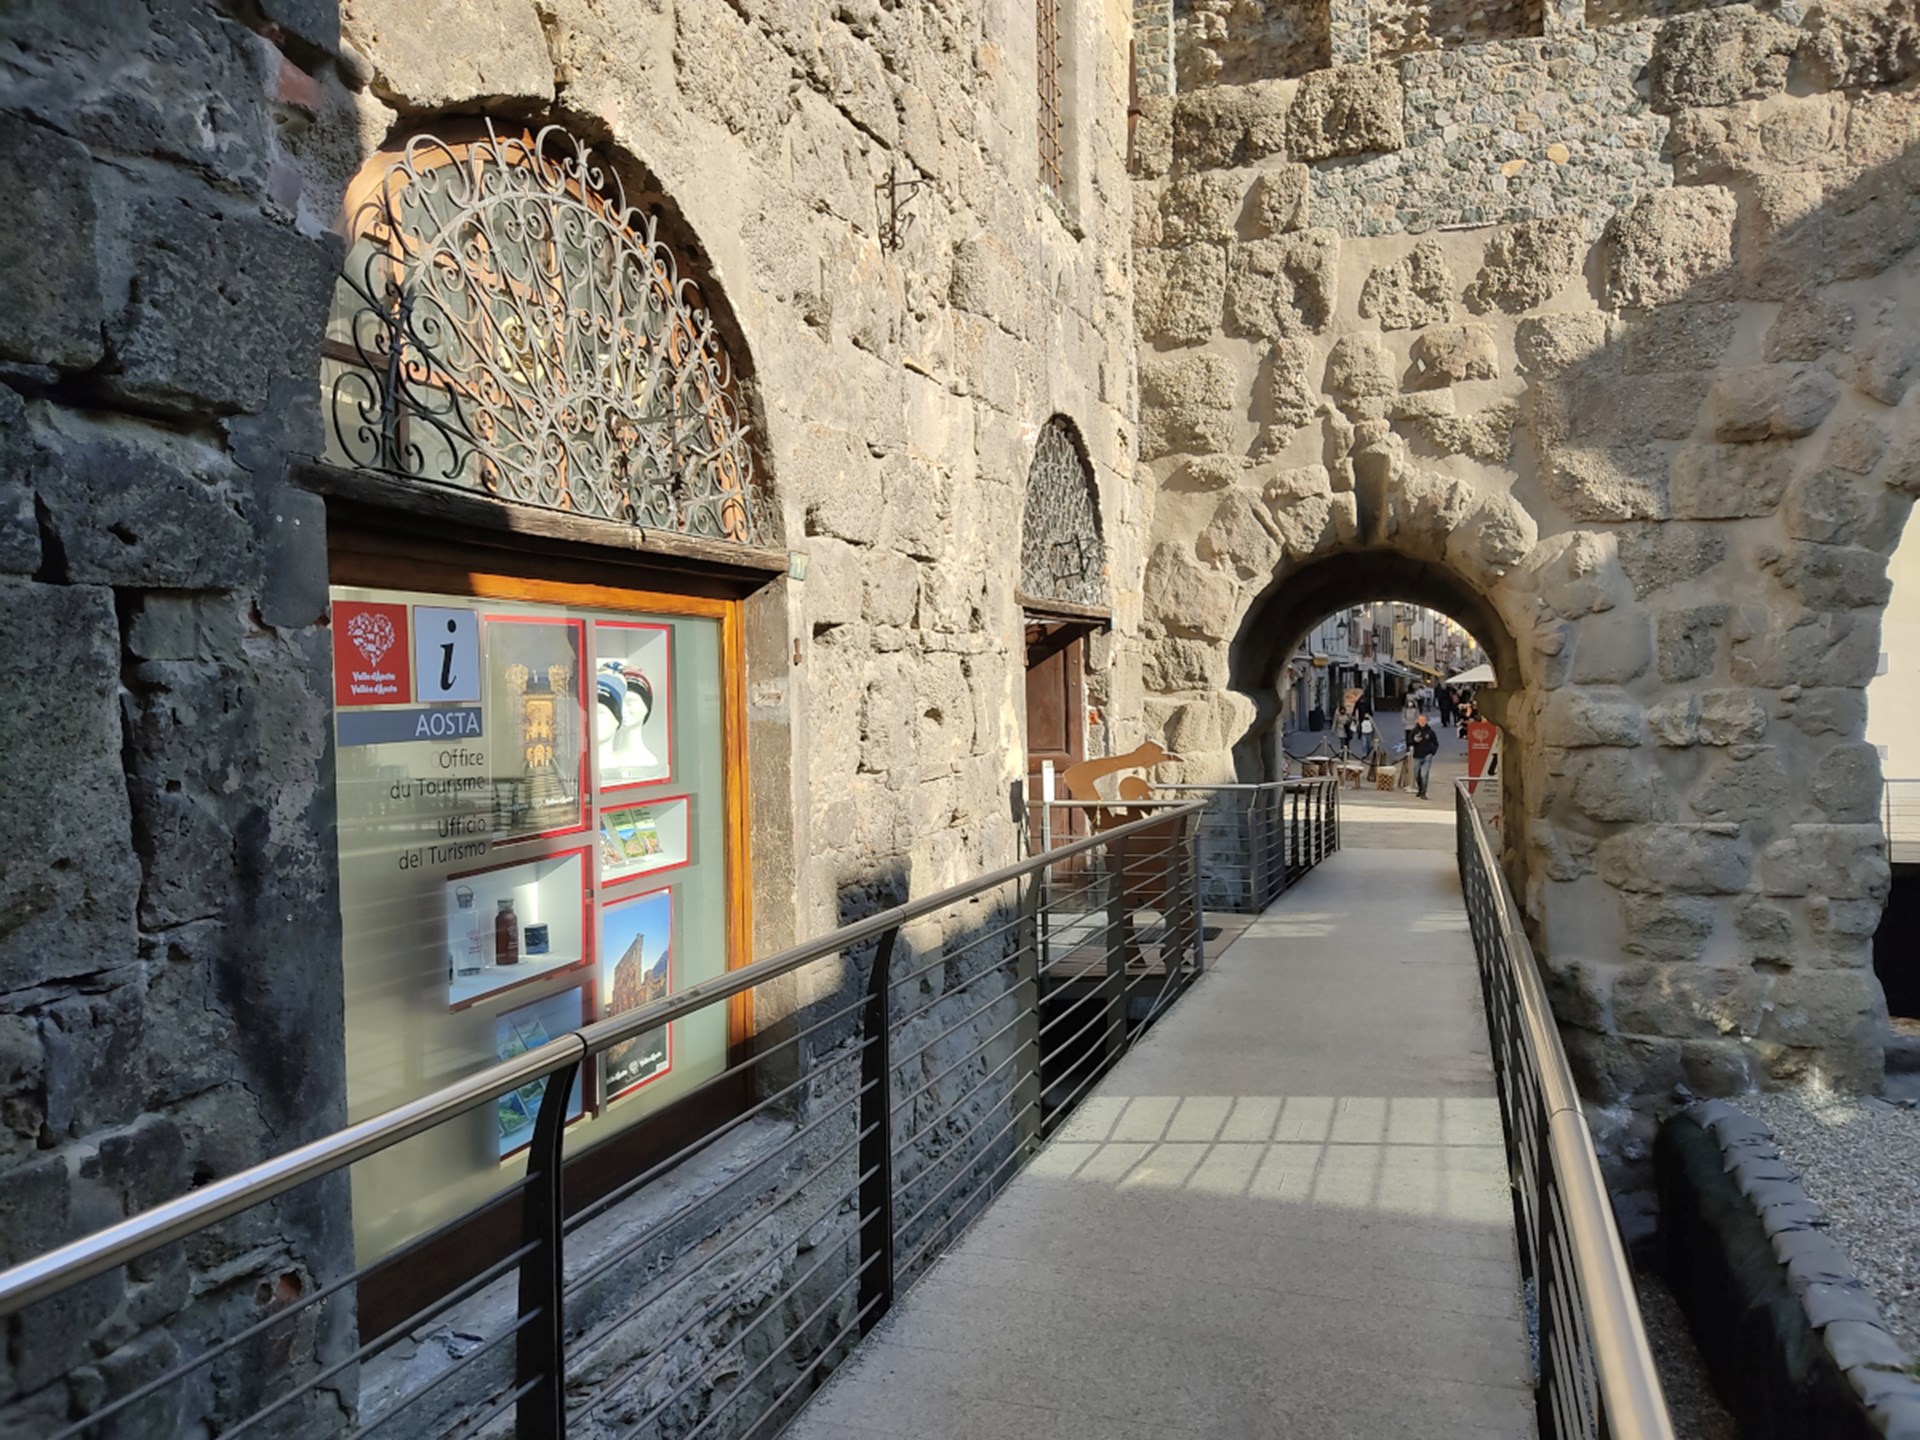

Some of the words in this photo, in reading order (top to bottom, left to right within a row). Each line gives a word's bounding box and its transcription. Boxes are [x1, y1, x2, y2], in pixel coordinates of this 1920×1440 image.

[415, 712, 480, 737] AOSTA
[440, 748, 484, 769] Office
[390, 780, 411, 799] du
[416, 774, 485, 796] Tourisme
[438, 815, 486, 838] Ufficio
[399, 848, 423, 870] del
[428, 841, 486, 864] Turismo
